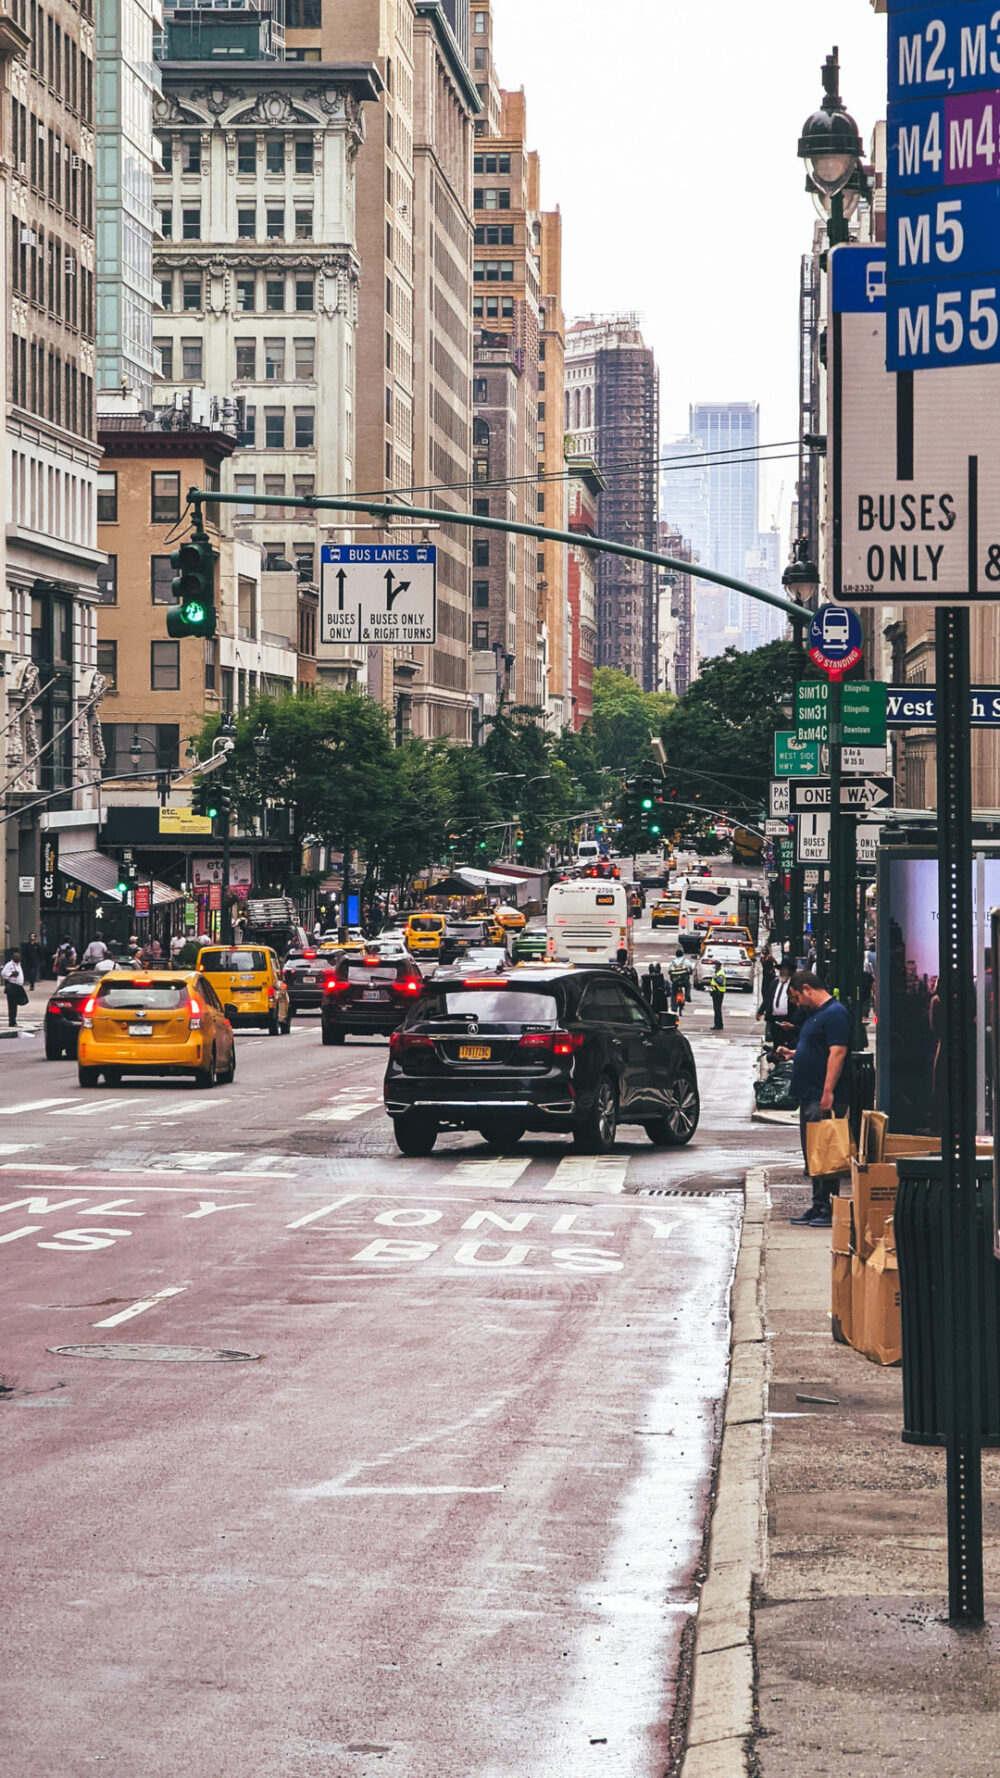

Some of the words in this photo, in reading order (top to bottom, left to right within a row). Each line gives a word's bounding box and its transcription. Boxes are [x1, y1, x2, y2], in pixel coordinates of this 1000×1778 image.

[898, 19, 955, 89] M2,
[898, 111, 942, 176] M4
[949, 105, 1000, 171] M4
[898, 200, 964, 267] M5
[898, 287, 998, 357] M55
[858, 494, 956, 531] BUSES
[349, 549, 371, 561] BUS
[374, 549, 409, 561] LANES
[867, 544, 944, 581] ONLY
[985, 544, 1000, 581] &
[327, 613, 355, 625] BUSES
[370, 613, 398, 625] BUSES
[401, 613, 425, 625] ONLY
[329, 628, 352, 639] ONLY
[362, 628, 370, 639] &
[374, 628, 399, 639] RIGHT
[402, 628, 431, 639] TURNS
[813, 650, 824, 663] NO
[823, 650, 859, 669] STANDING
[798, 684, 828, 700] SIM10
[798, 705, 827, 720] SIM31
[886, 697, 934, 716] West
[798, 725, 828, 741] BxM4C
[843, 725, 871, 734] Downtown
[779, 752, 797, 760] WEST
[800, 752, 816, 760] SIDE
[804, 789, 831, 803] ONE
[847, 788, 879, 803] WAY
[161, 808, 178, 816] etc.
[803, 838, 825, 847] BUSES
[860, 838, 879, 848] ONLY
[805, 849, 822, 857] ONLY
[861, 849, 877, 859] TUR
[42, 874, 54, 899] etc.
[373, 1208, 689, 1238] ONLY
[350, 1238, 625, 1272] BUS
